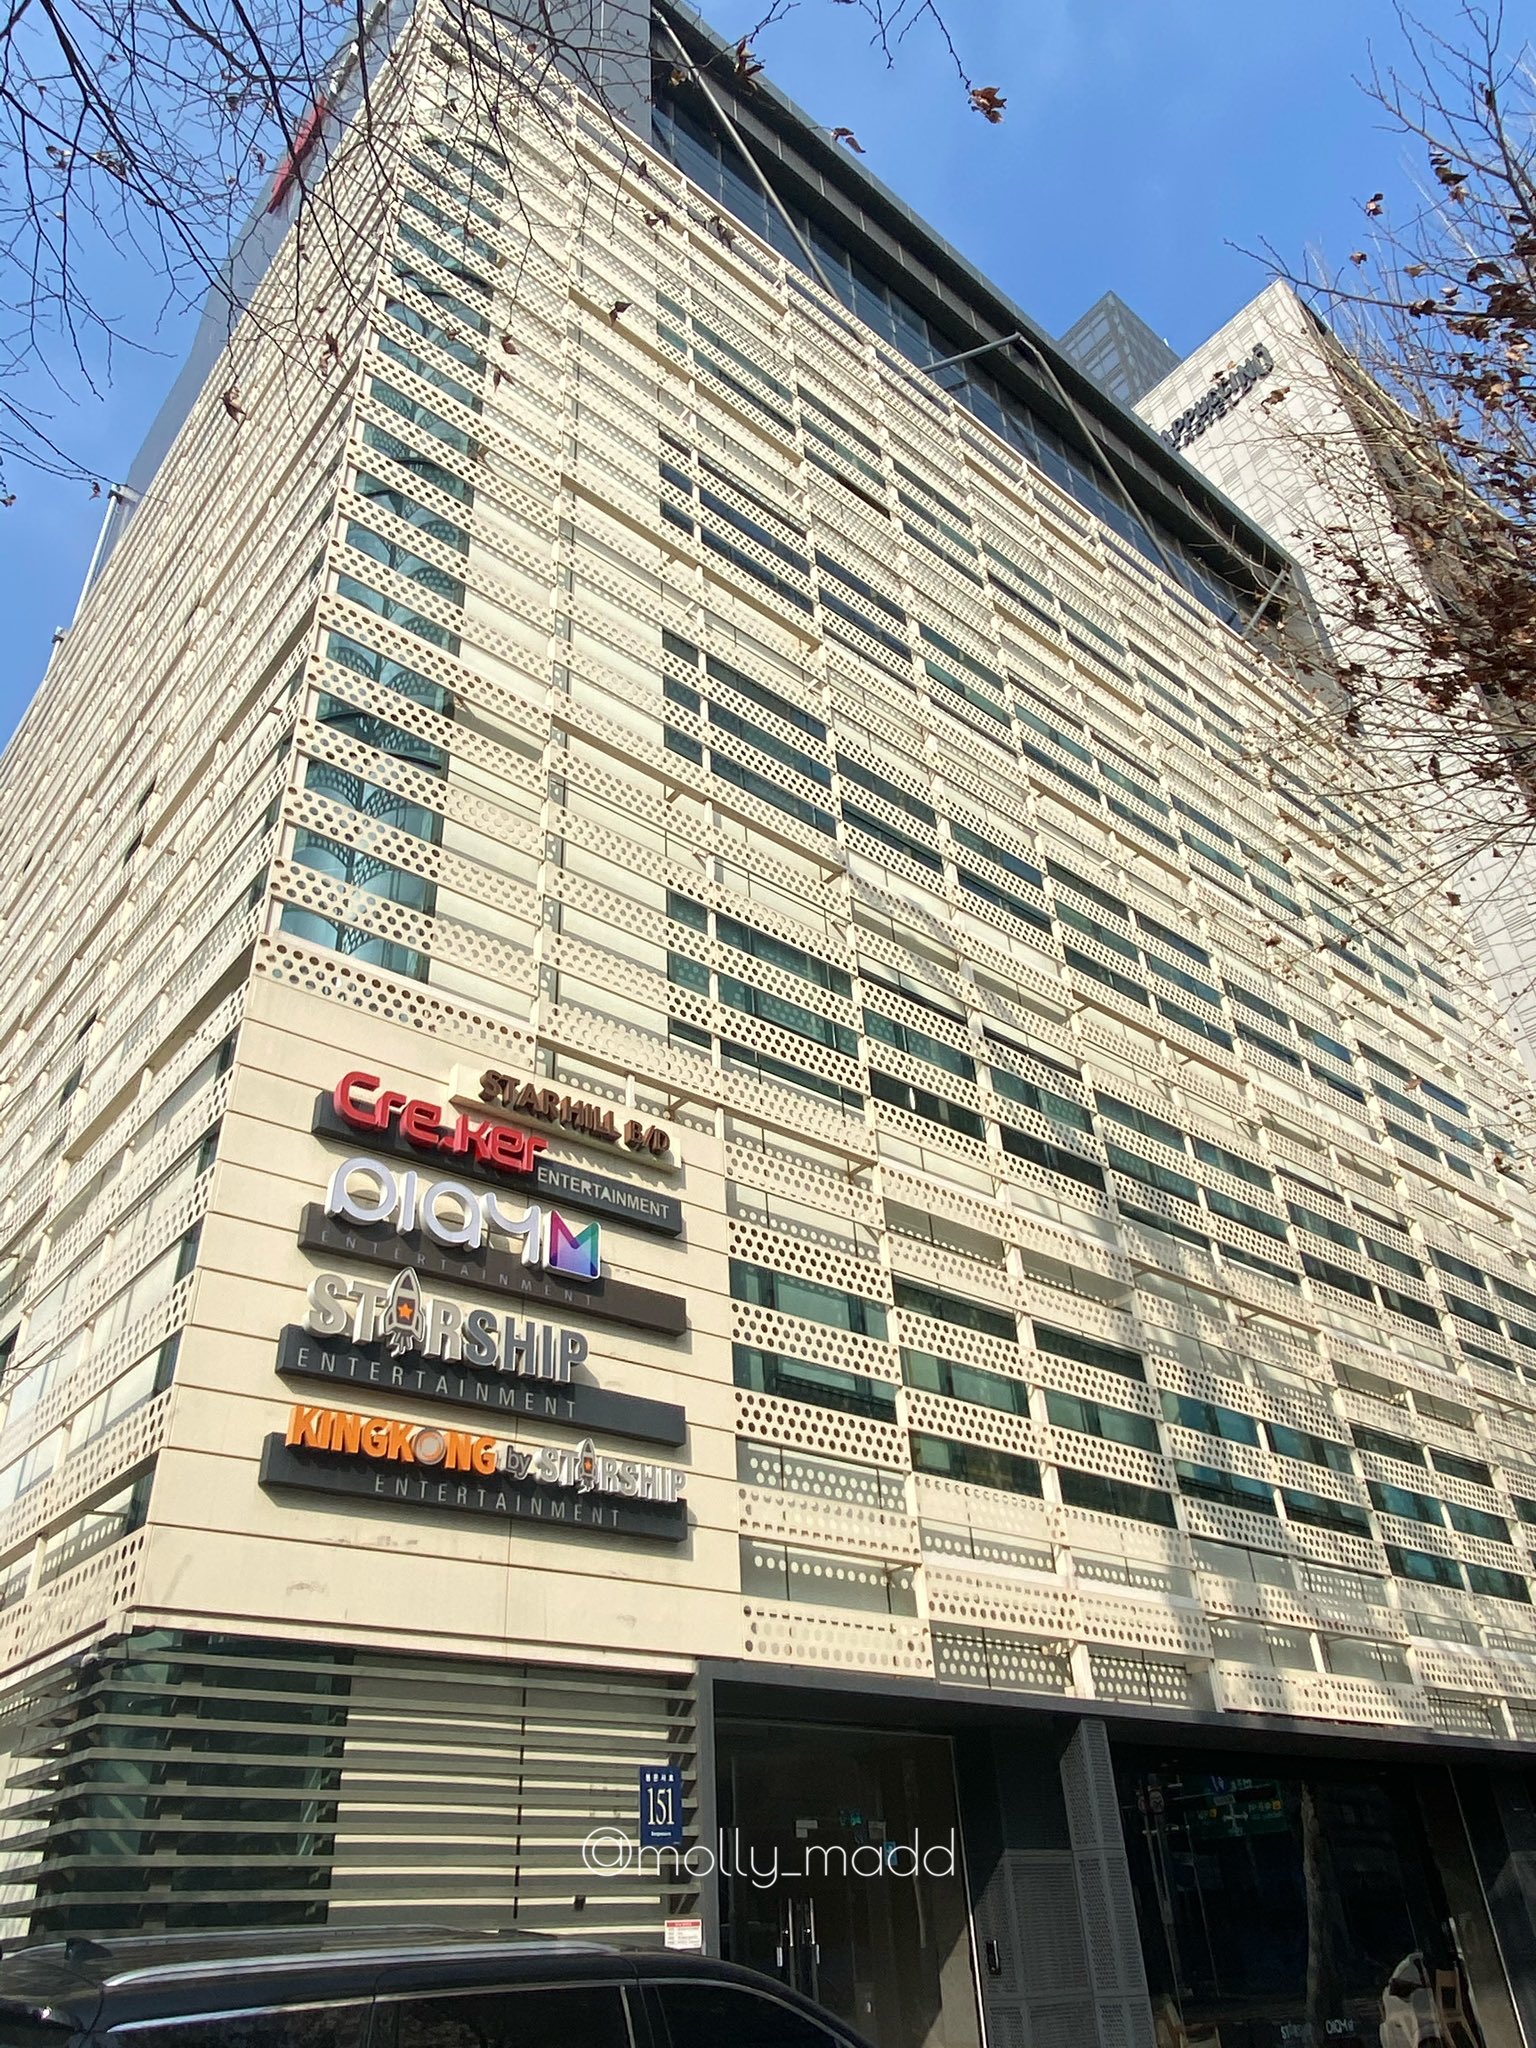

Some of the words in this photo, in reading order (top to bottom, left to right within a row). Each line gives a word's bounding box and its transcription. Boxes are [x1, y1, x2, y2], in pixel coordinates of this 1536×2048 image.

[624, 1119, 671, 1155] B/D
[537, 1166, 670, 1220] ENTERTAINMENT
[321, 1230, 594, 1306] ENTERTAINMENT
[304, 1266, 589, 1384] STARSHIP
[297, 1346, 577, 1419] ENTERTAINMENT
[285, 1404, 497, 1476] KINGKONG
[501, 1445, 533, 1481] by
[535, 1437, 688, 1503] STARSHIP
[375, 1473, 621, 1527] ENTERTAINMENT
[647, 1787, 675, 1825] 151
